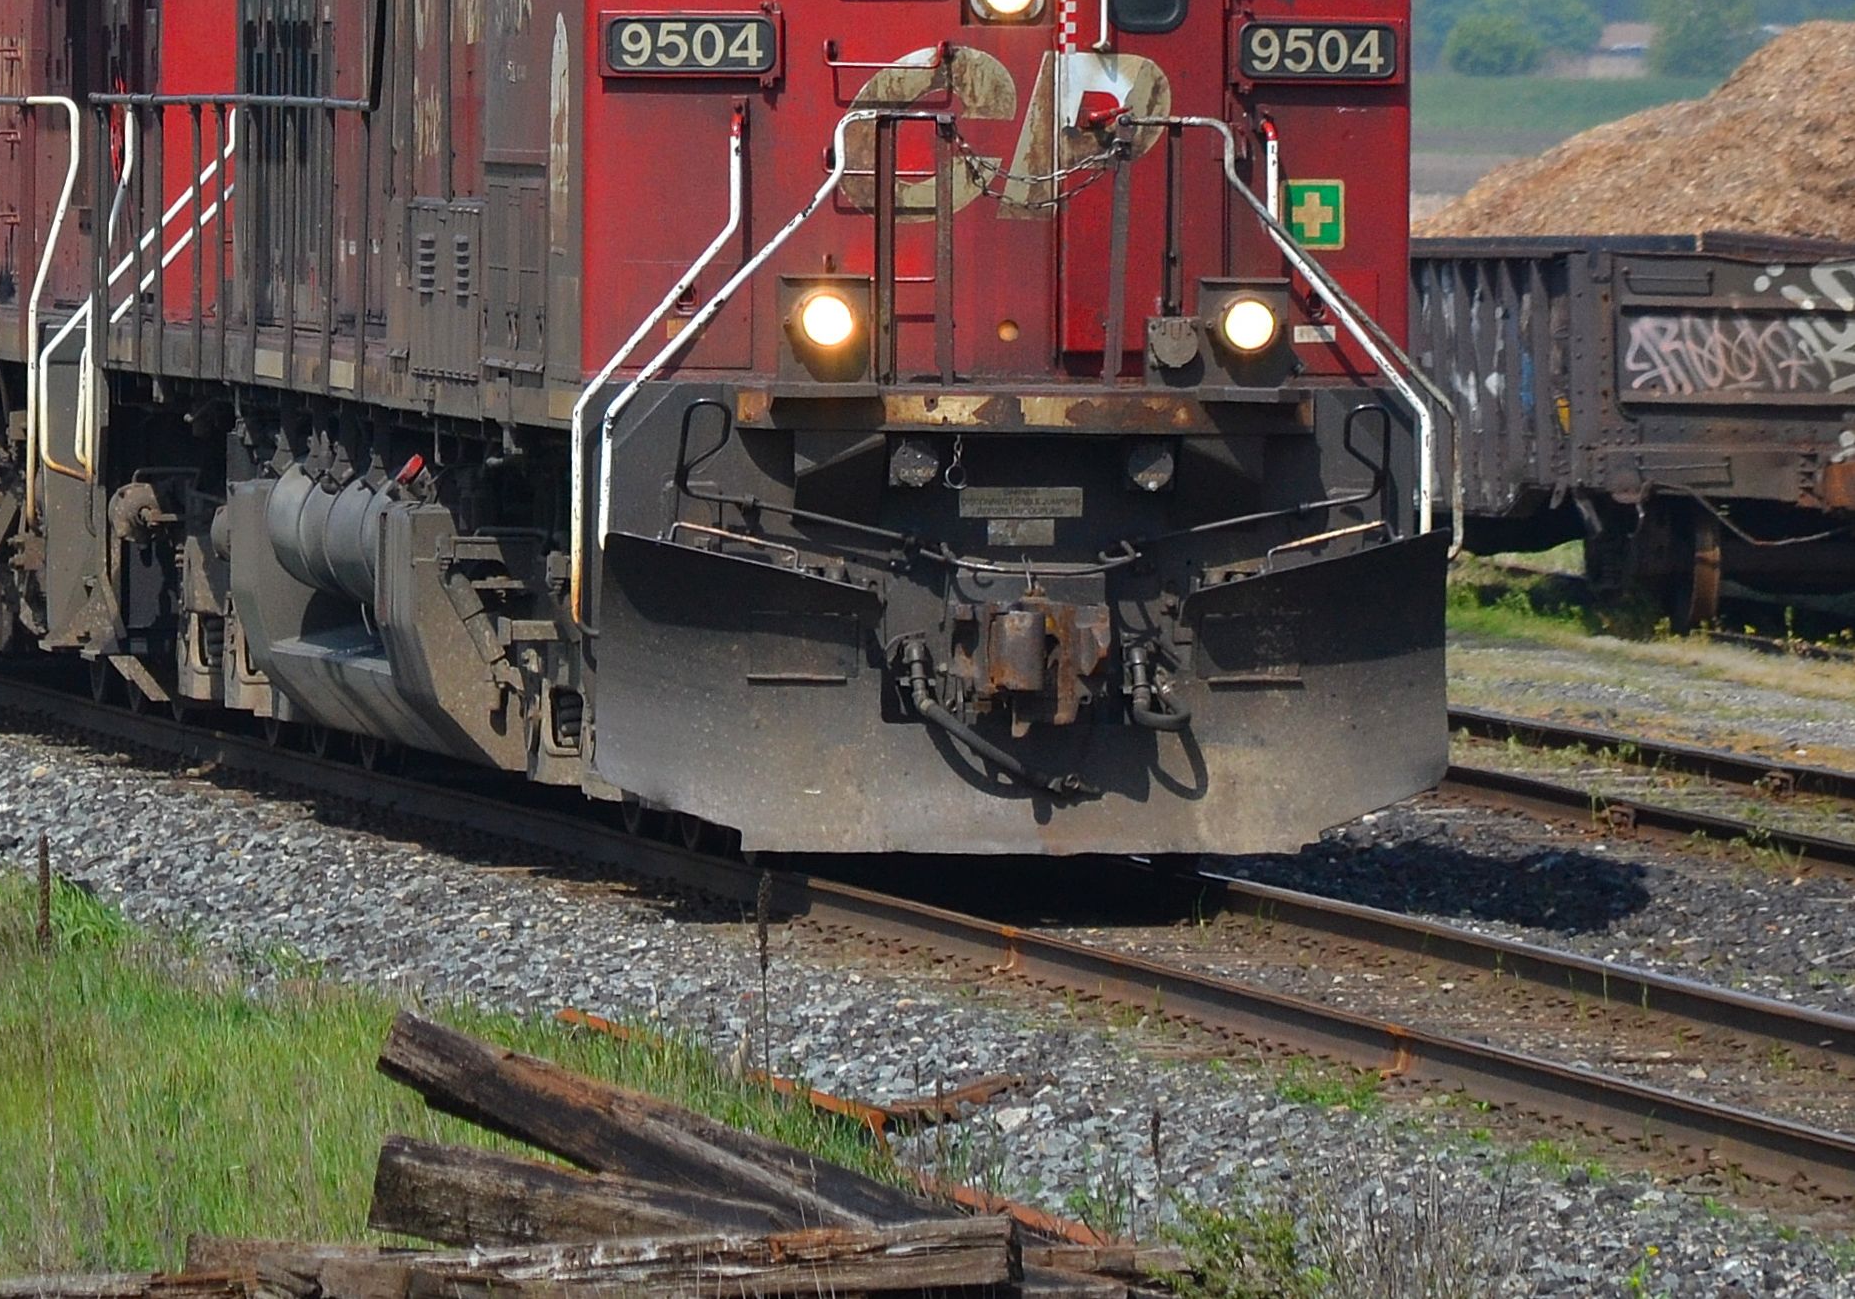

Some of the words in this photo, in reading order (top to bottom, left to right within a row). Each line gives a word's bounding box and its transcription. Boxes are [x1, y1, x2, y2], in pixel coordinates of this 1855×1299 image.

[620, 22, 763, 68] 9504
[1250, 28, 1384, 73] 9504
[838, 46, 1171, 223] CP
